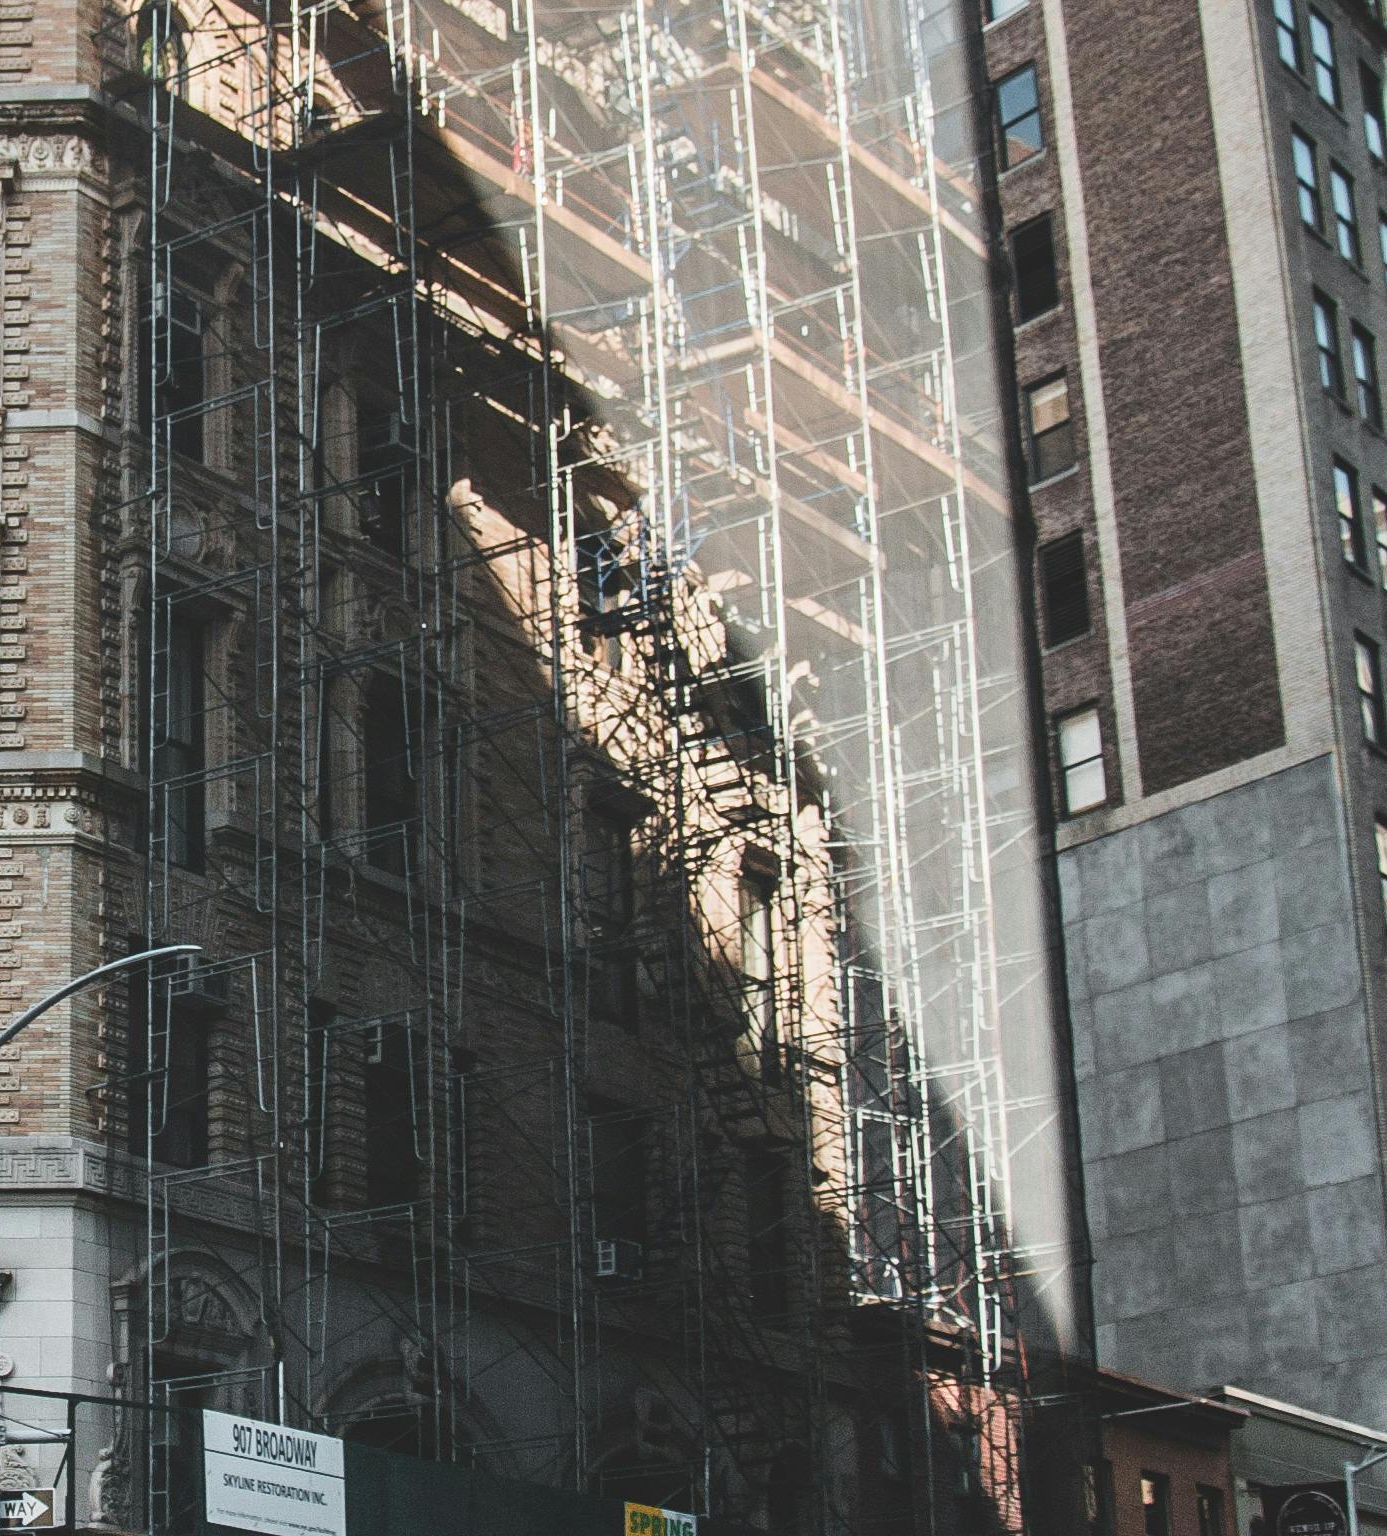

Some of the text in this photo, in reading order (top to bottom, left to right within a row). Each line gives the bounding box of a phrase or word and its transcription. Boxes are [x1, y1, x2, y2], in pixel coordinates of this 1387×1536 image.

[232, 1423, 318, 1468] 907 BROADWAY
[223, 1473, 255, 1492] SKYLINE
[257, 1479, 310, 1503] RESTORATION
[4, 1502, 37, 1516] WAY
